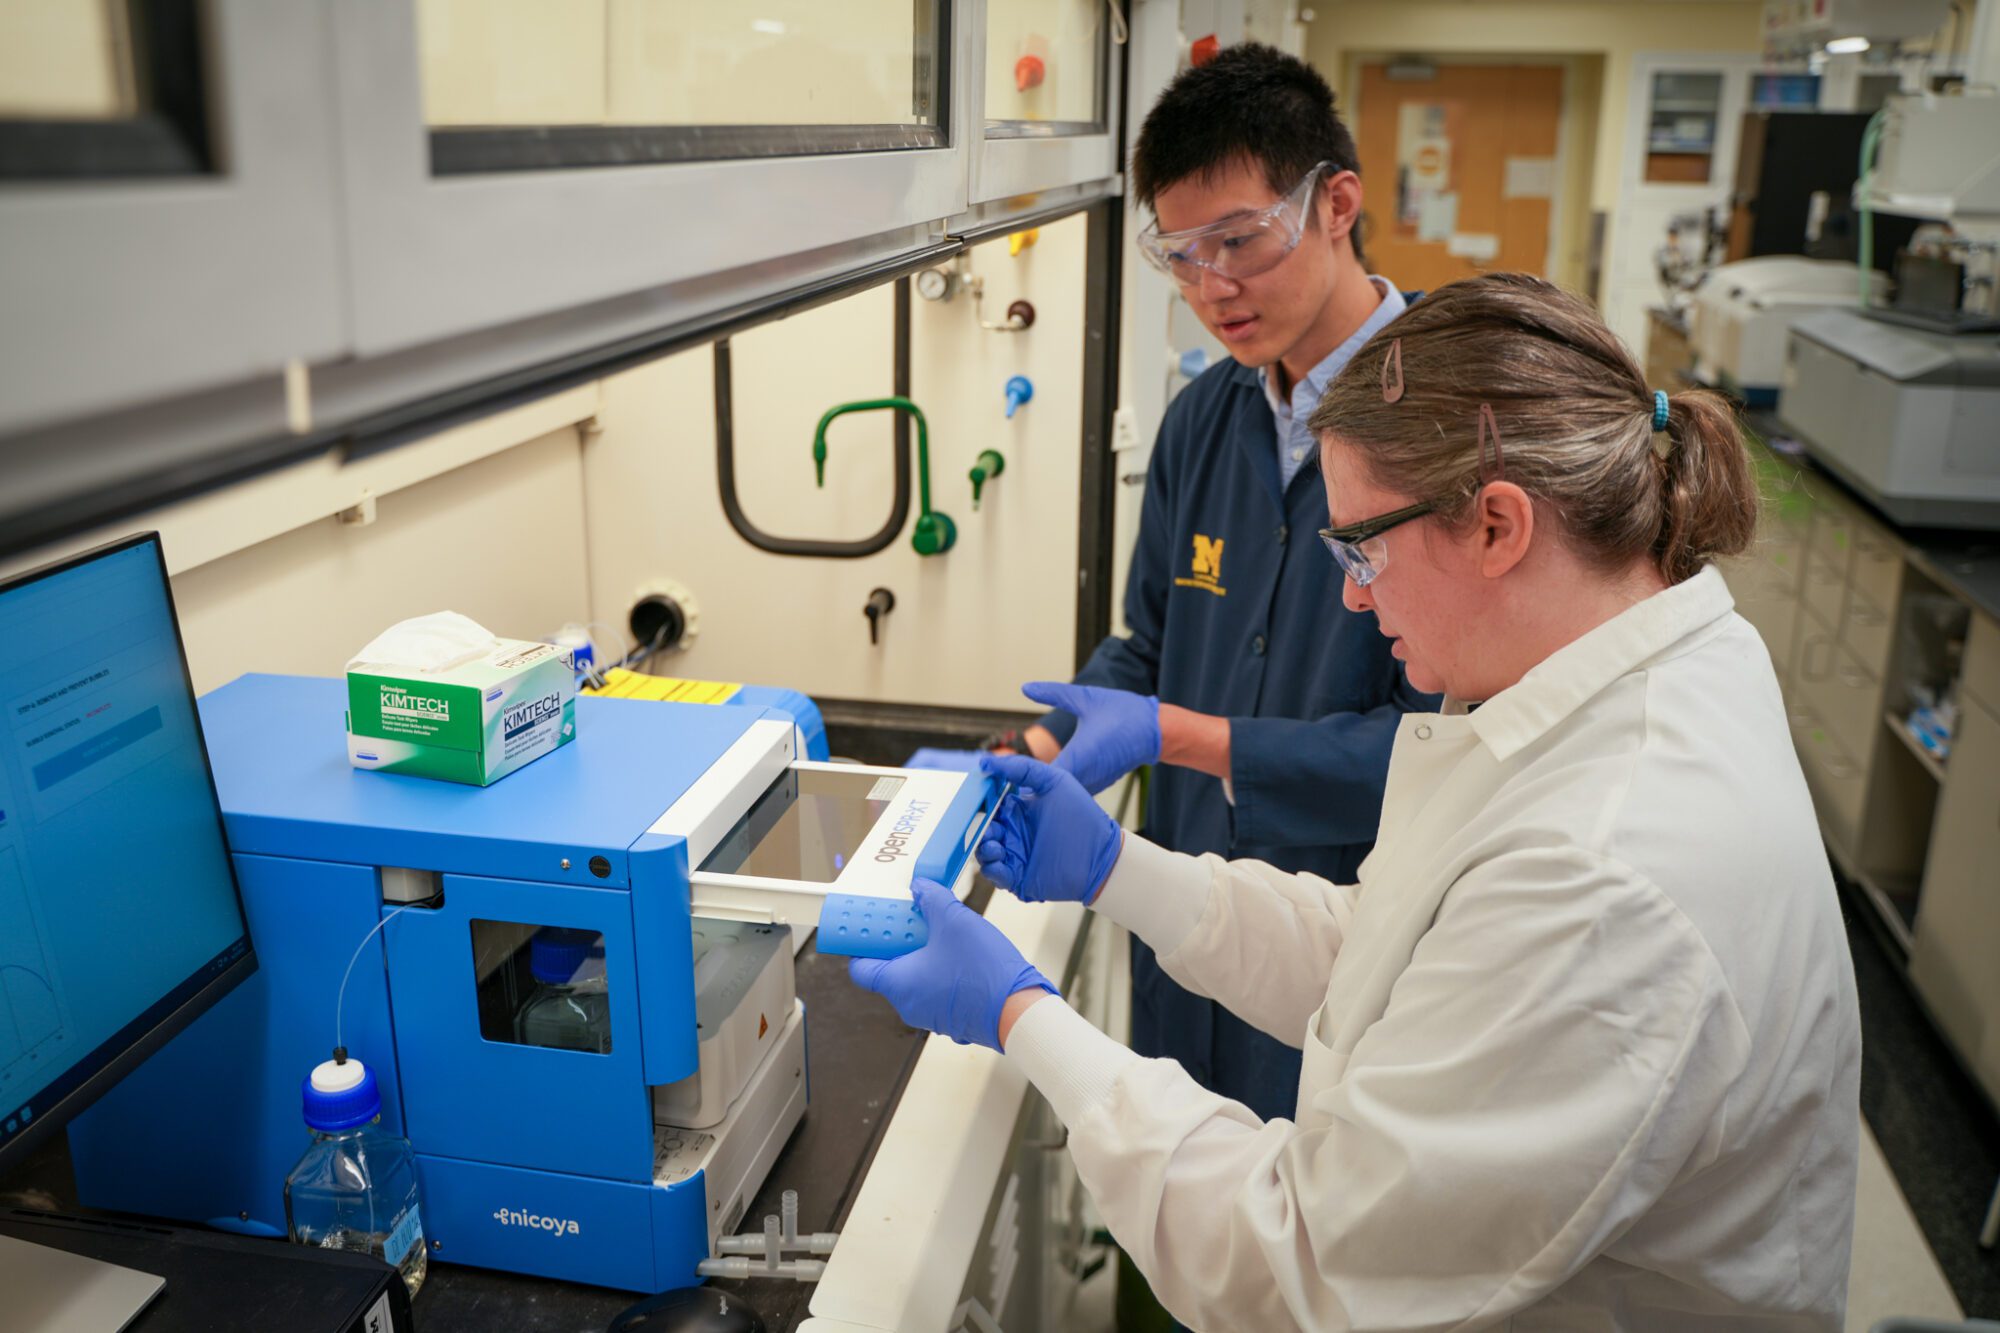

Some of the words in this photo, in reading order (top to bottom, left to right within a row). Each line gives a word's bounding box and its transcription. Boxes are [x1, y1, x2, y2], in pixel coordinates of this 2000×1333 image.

[381, 692, 449, 714] KIMTECH
[504, 691, 560, 732] KIMTECH
[510, 1208, 580, 1237] nicoya
